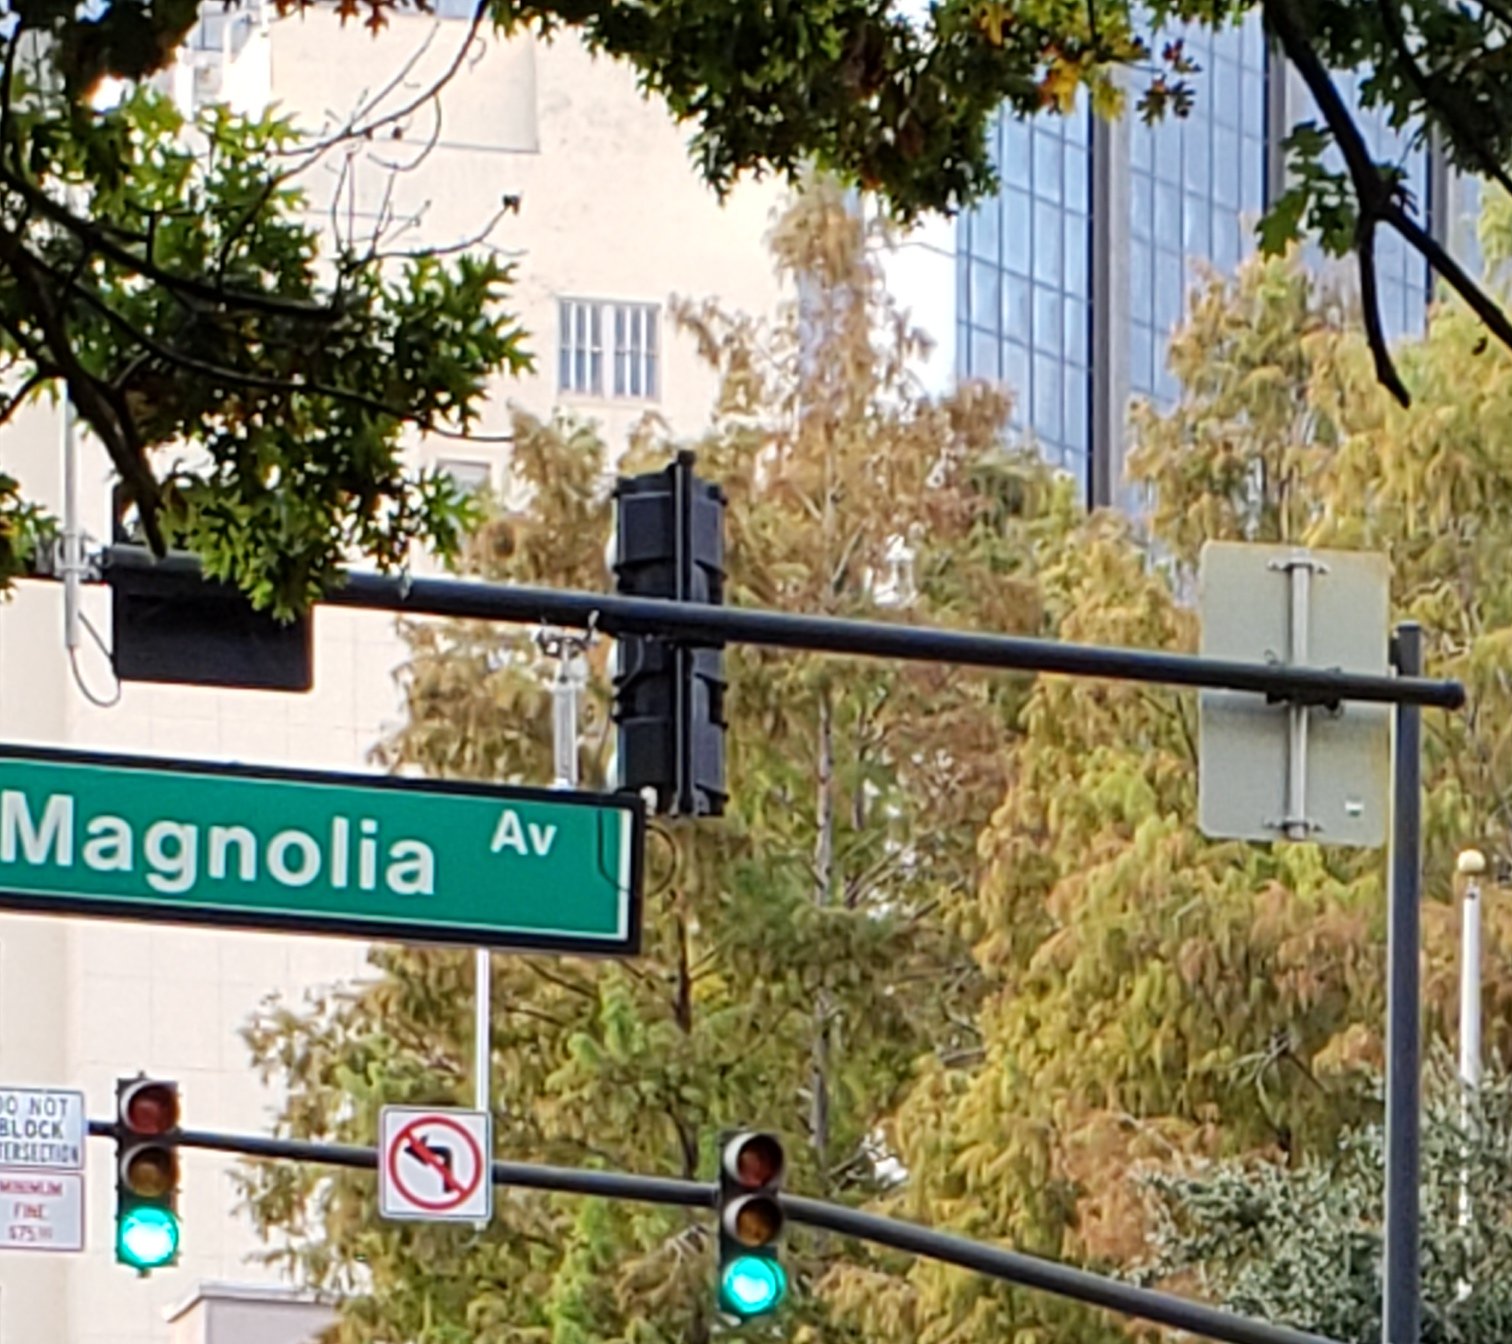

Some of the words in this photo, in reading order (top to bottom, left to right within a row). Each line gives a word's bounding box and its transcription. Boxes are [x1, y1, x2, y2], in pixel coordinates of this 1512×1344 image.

[0, 790, 436, 896] Magnolia
[490, 810, 557, 857] Av
[29, 1096, 69, 1118] NOT
[0, 1118, 64, 1140] BLOCK
[14, 1202, 48, 1221] FINE
